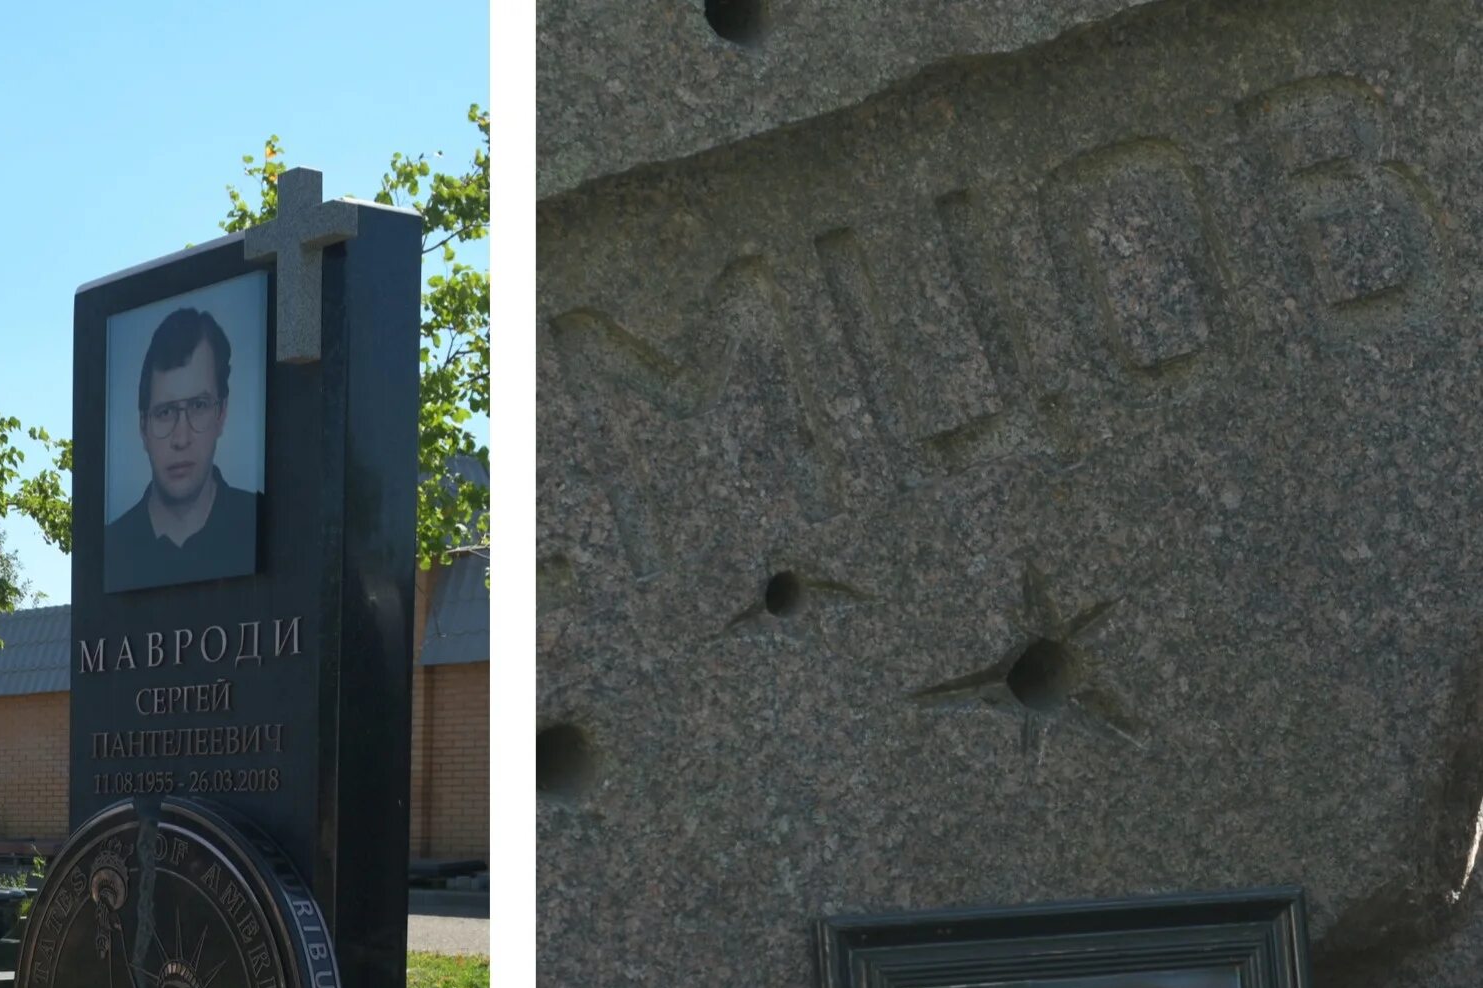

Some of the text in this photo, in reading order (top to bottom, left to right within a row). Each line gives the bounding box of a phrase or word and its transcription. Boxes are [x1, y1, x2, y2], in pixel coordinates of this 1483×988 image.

[79, 616, 302, 673] МАВРОДИ
[135, 678, 233, 715] СЕРГЕЙ
[91, 724, 284, 759] ПАНТЕЛЕЕВИЧ
[93, 771, 174, 794] 11.08.1955
[188, 767, 280, 793] 26.03.2018
[152, 832, 189, 865] OF
